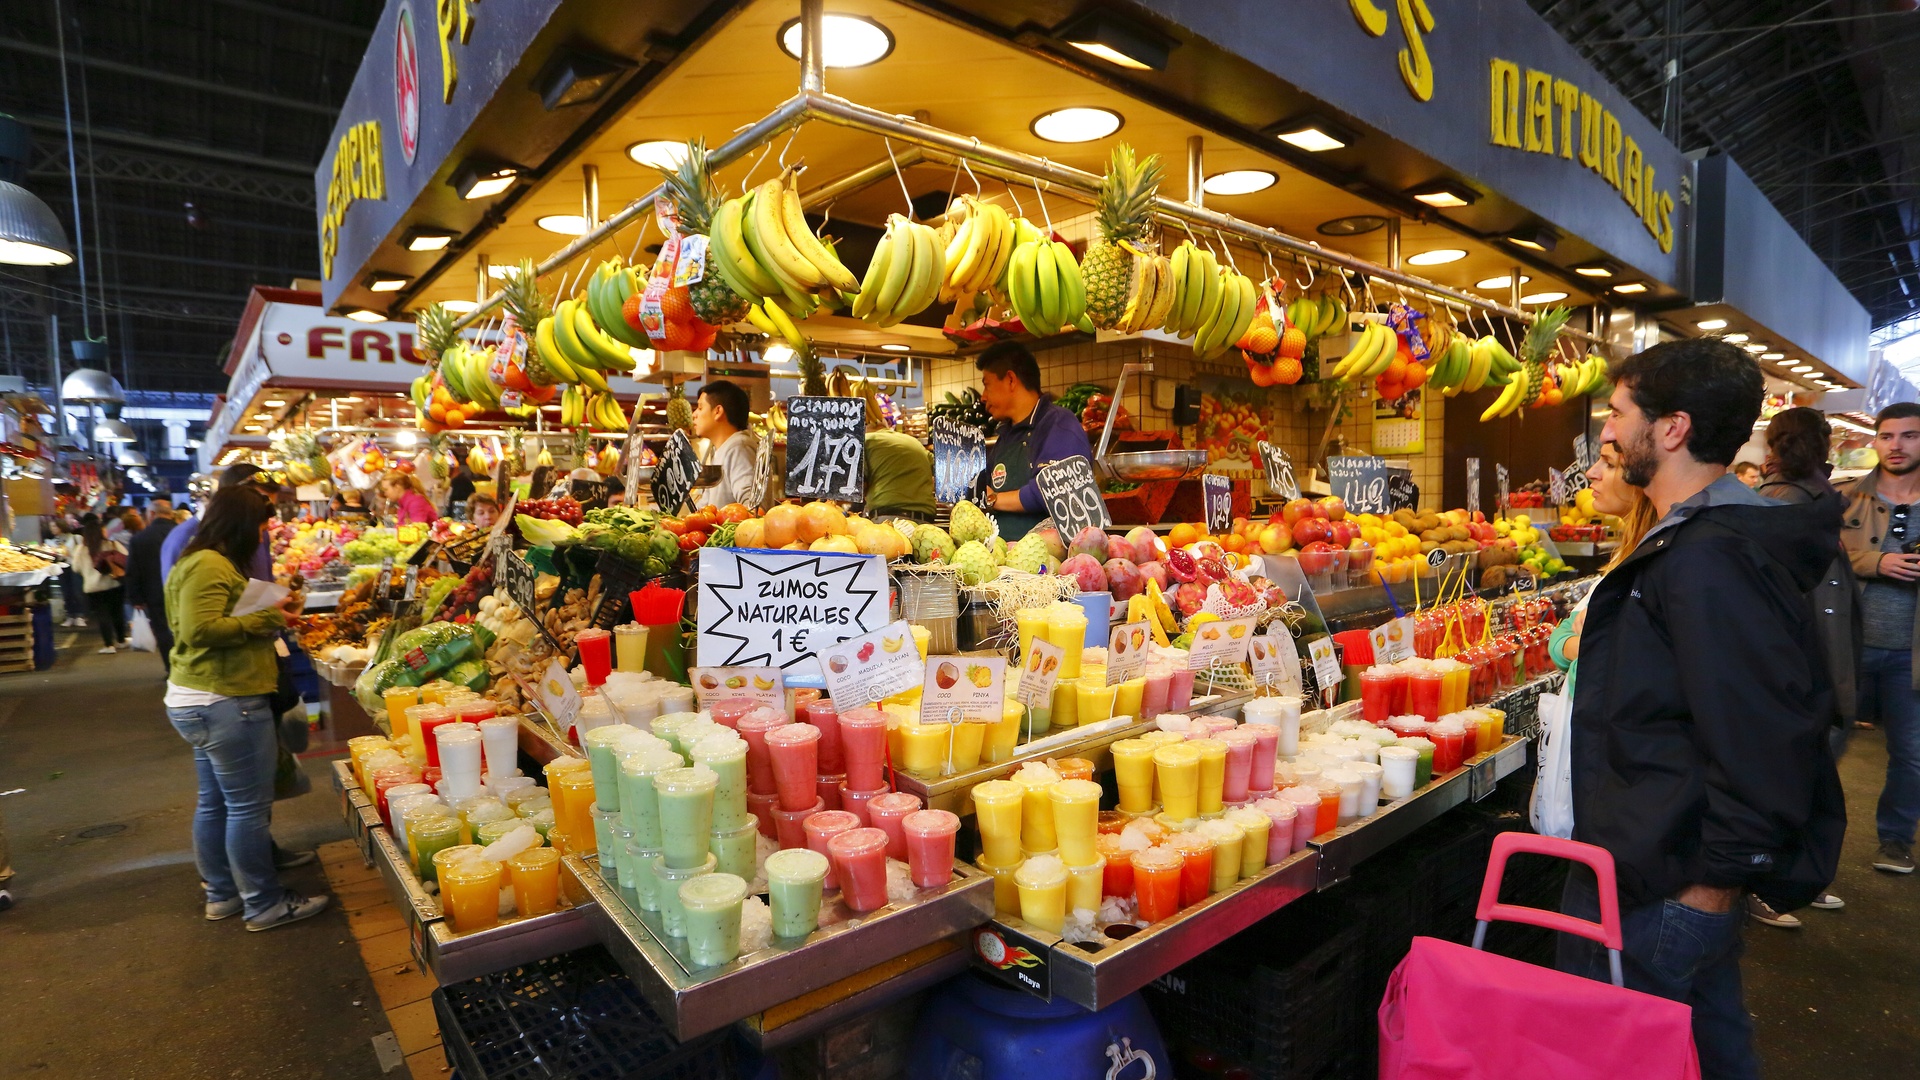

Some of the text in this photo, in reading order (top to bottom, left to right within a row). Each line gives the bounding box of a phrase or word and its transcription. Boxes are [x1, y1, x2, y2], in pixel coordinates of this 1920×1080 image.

[789, 429, 863, 496] 1,79
[757, 579, 829, 600] ZUMOS
[738, 602, 851, 625] NATURALES
[836, 674, 852, 684] COCO
[1018, 972, 1041, 989] Pitaya
